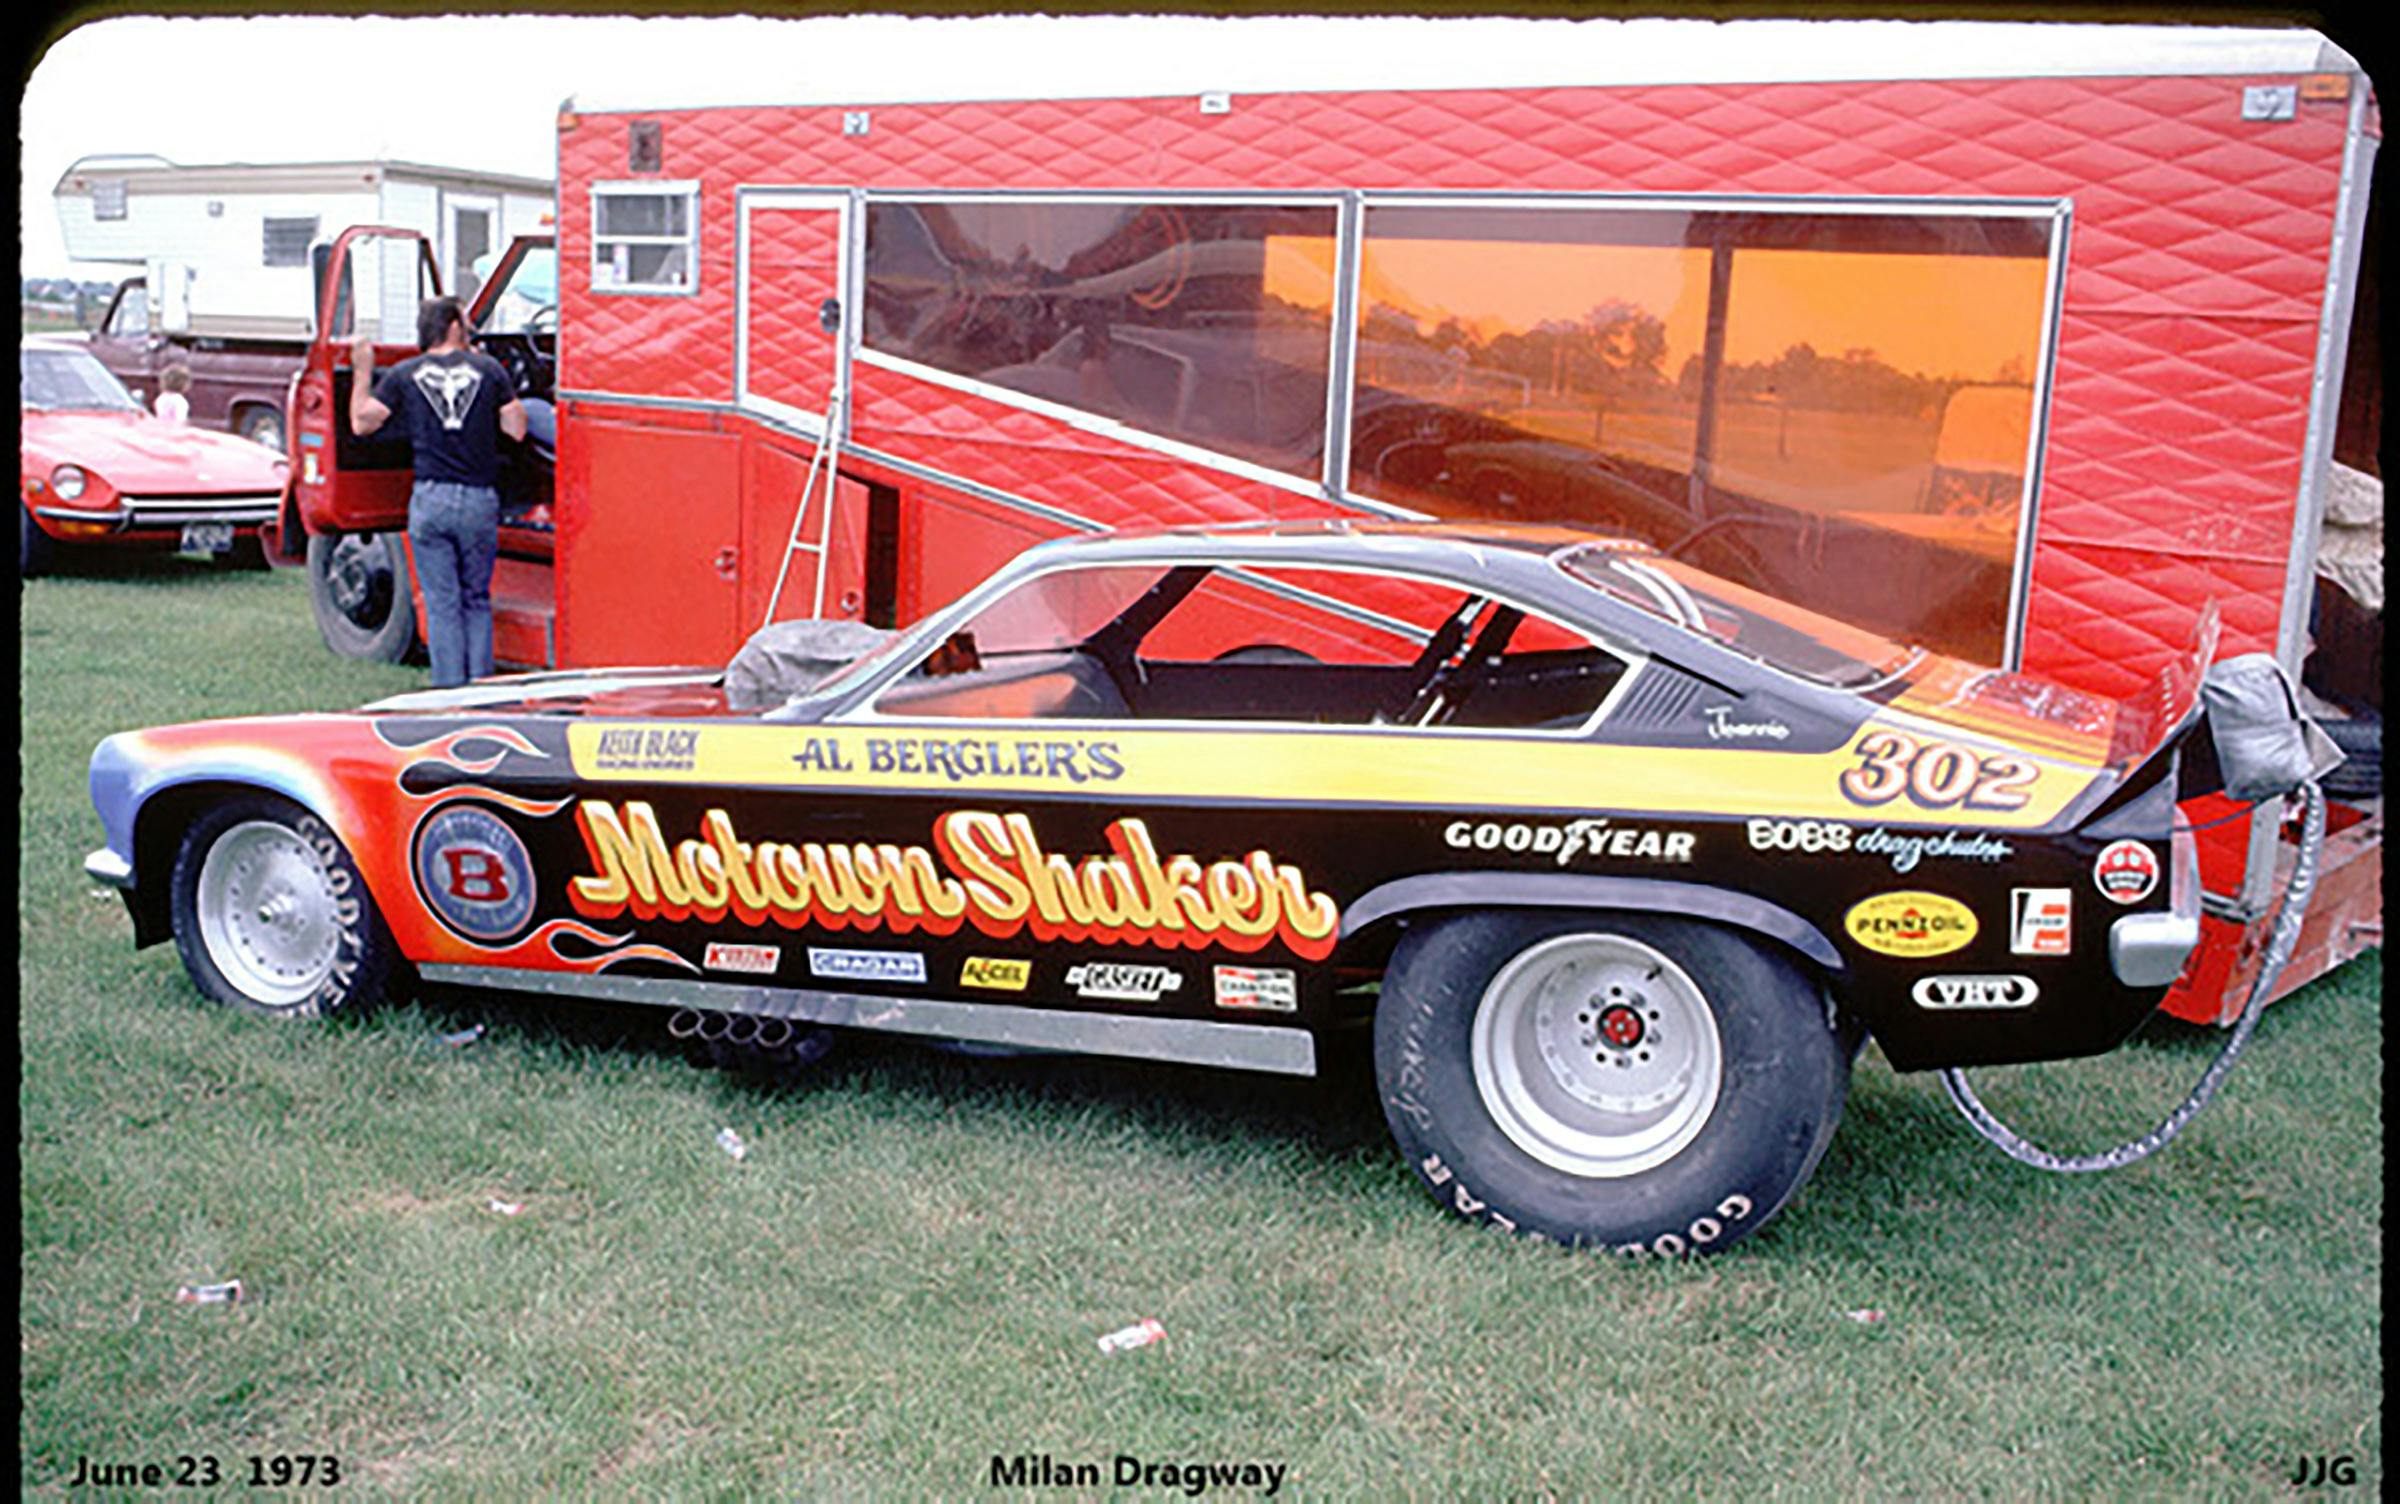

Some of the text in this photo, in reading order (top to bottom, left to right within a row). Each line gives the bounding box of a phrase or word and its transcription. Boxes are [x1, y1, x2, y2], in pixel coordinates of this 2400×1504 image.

[792, 738, 1126, 783] AL BERGLER'S
[1839, 730, 2042, 811] 302
[1444, 818, 1697, 866] GOODYEAR
[441, 847, 511, 902] B
[566, 800, 1340, 960] Motown Shaker
[1856, 915, 1966, 934] PENNZOIL
[1934, 980, 2014, 1004] VHT
